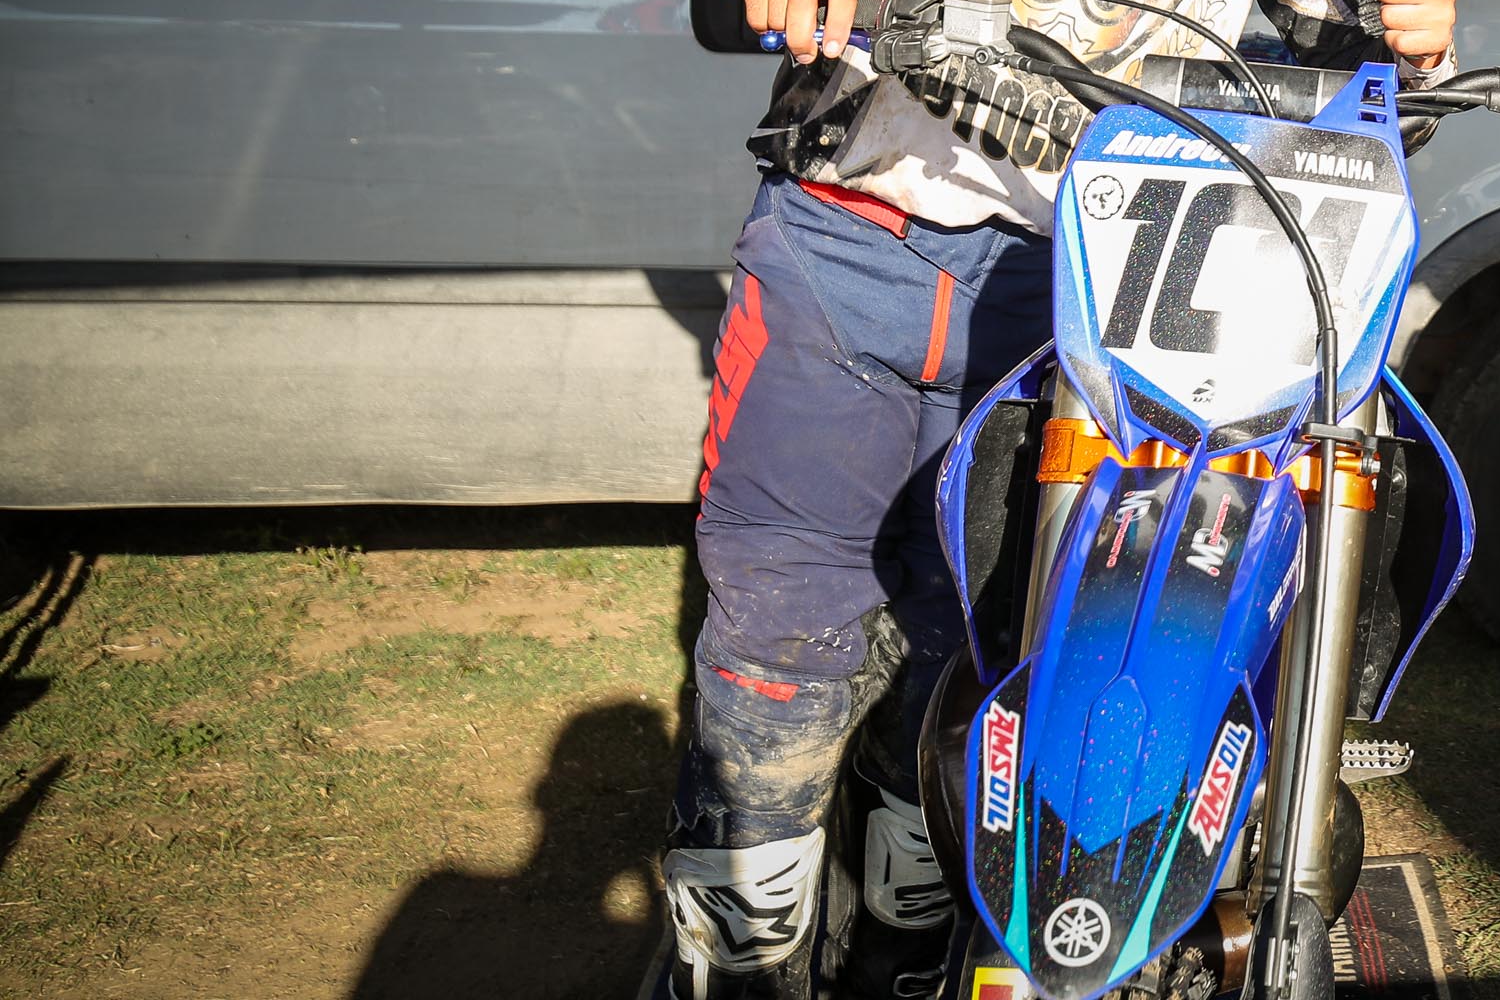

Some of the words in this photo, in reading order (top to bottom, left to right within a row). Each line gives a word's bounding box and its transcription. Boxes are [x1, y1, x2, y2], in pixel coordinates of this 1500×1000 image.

[1293, 151, 1375, 182] YAMAHA
[984, 703, 1018, 830] AMSOIL
[1191, 725, 1251, 853] AMSOIL
